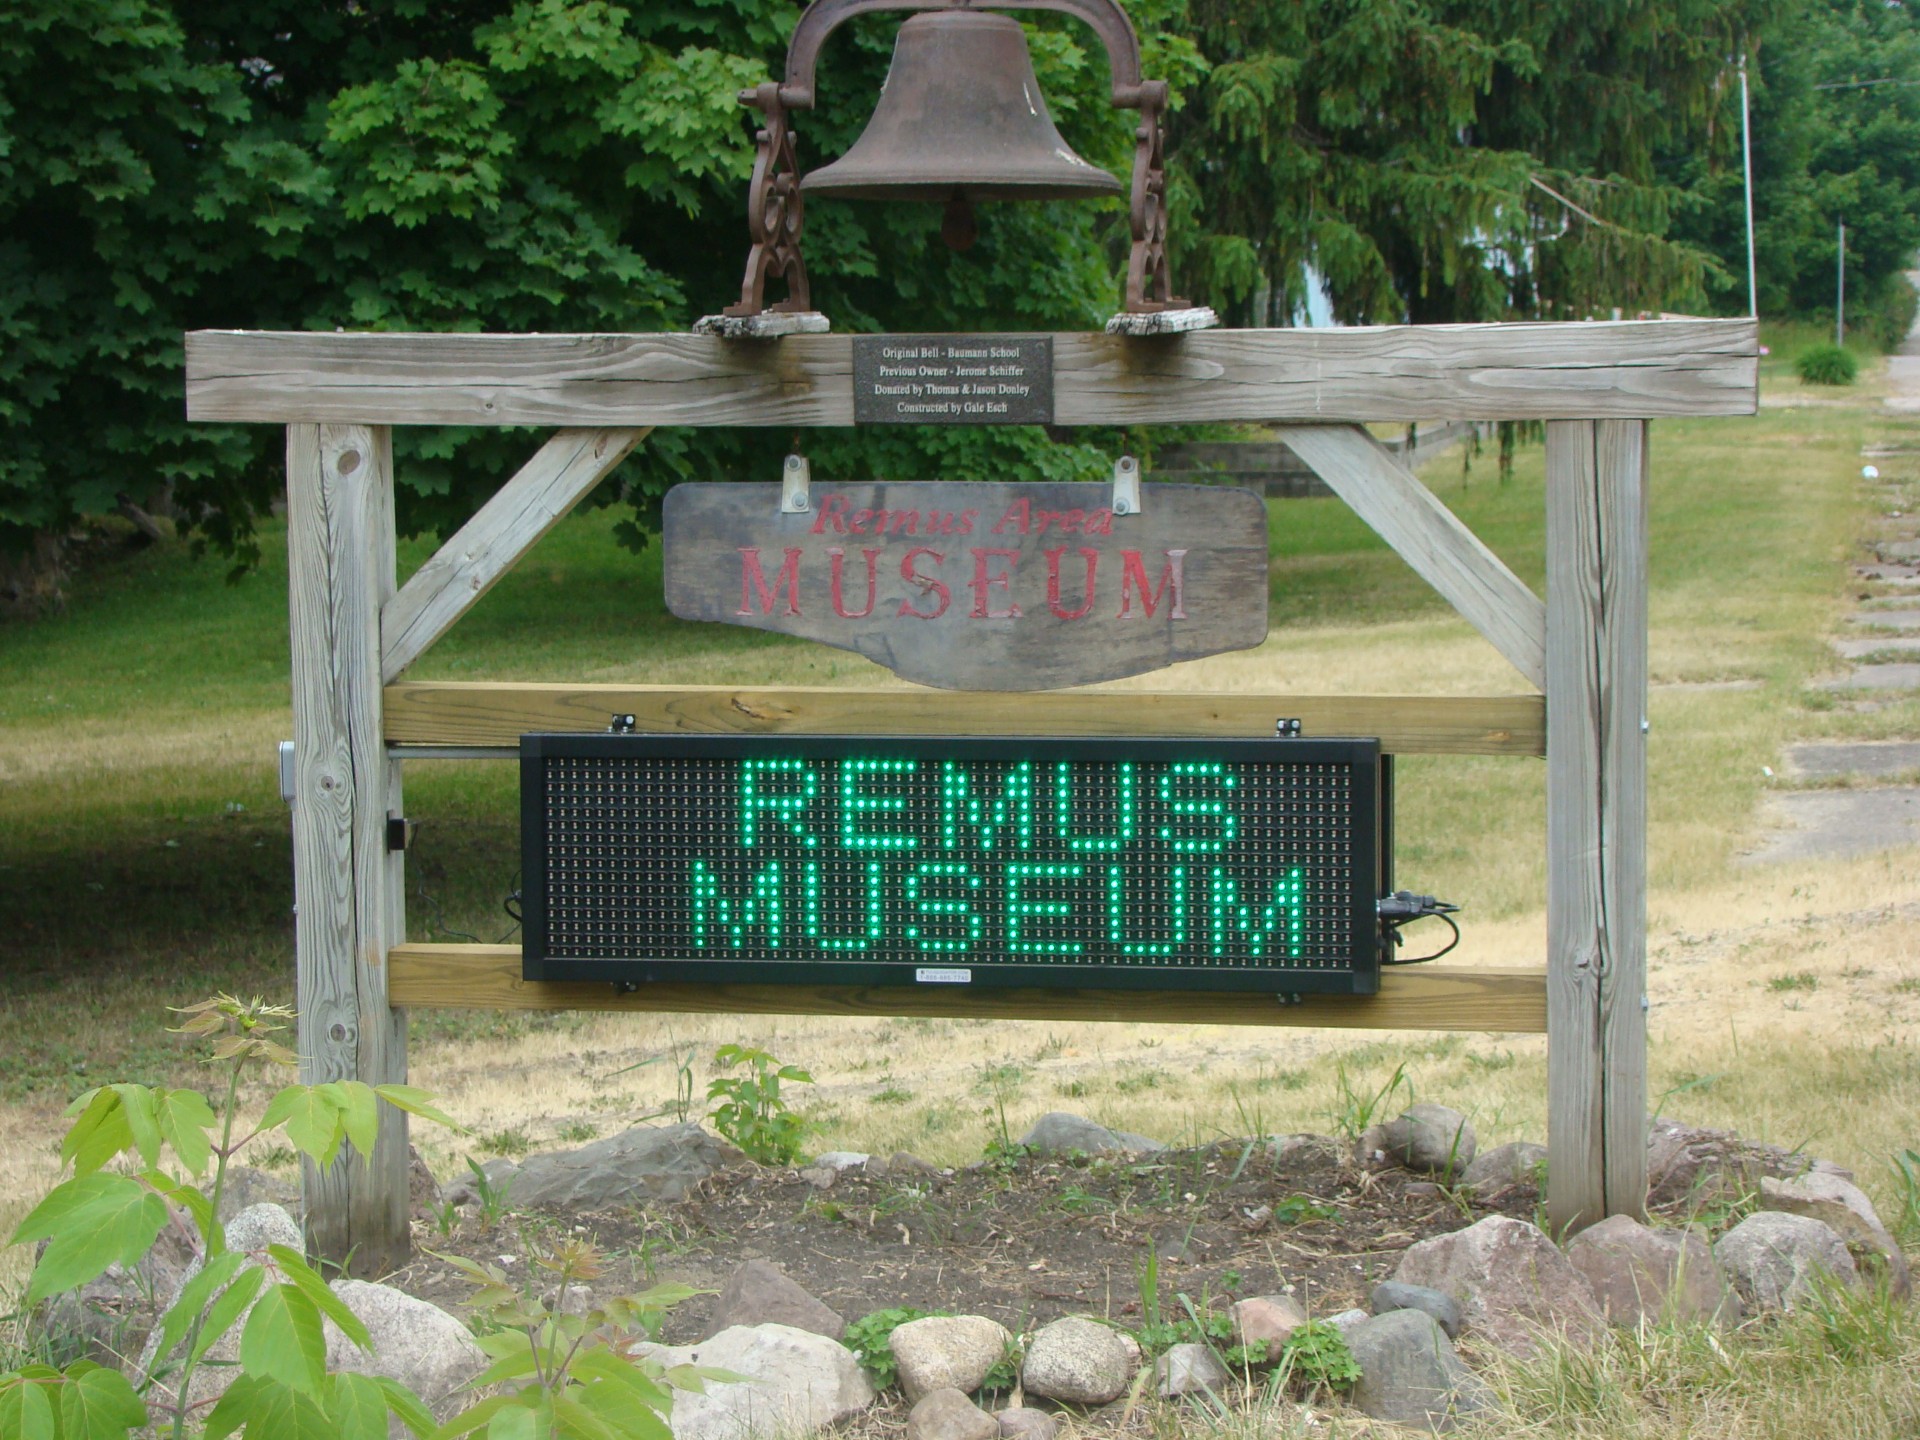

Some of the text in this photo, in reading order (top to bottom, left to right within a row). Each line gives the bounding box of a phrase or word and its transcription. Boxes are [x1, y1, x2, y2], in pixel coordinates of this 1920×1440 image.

[882, 347, 919, 360] Original
[920, 347, 939, 358] Bell
[948, 347, 988, 358] Baumann
[990, 347, 1020, 358] School
[879, 365, 917, 377] Previous
[918, 365, 948, 377] Owner
[956, 365, 987, 377] Jerome
[989, 365, 1025, 376] Schiffer
[874, 384, 1030, 397] Donated by Thomas & Jason Donley
[897, 402, 1008, 416] Constructed by Gale Esch
[808, 494, 1114, 536] Remus Area
[736, 545, 1188, 621] MUSEUM
[743, 759, 1235, 851] REMUS
[694, 860, 1301, 957] MUSEUM
